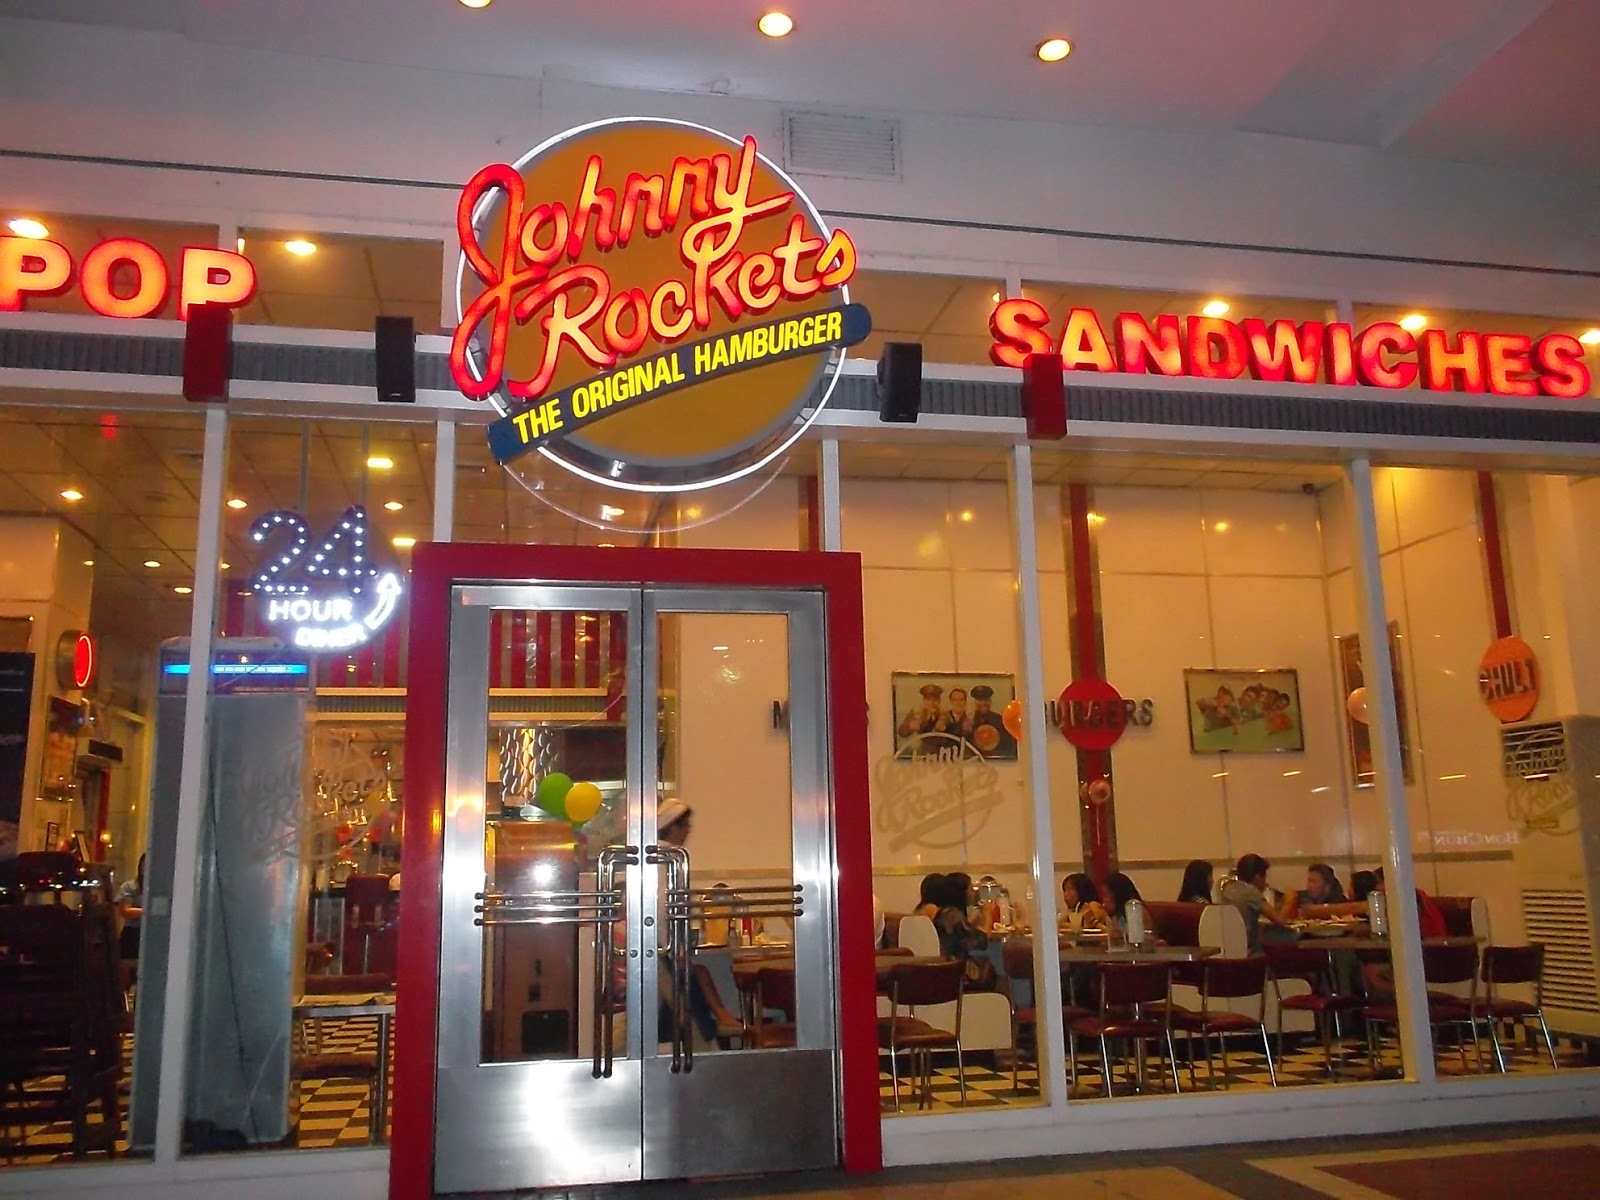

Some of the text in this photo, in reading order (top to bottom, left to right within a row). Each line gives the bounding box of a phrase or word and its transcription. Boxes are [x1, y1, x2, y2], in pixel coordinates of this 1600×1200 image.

[0, 235, 256, 320] POP
[449, 135, 796, 402] Johnny
[507, 214, 857, 398] Rockets
[513, 311, 842, 445] THE ORIGINAL HAMBURGER
[989, 298, 1590, 398] SANDWICHES
[250, 504, 378, 597] 24
[268, 599, 353, 622] HOUR
[1044, 698, 1154, 729] URGERS
